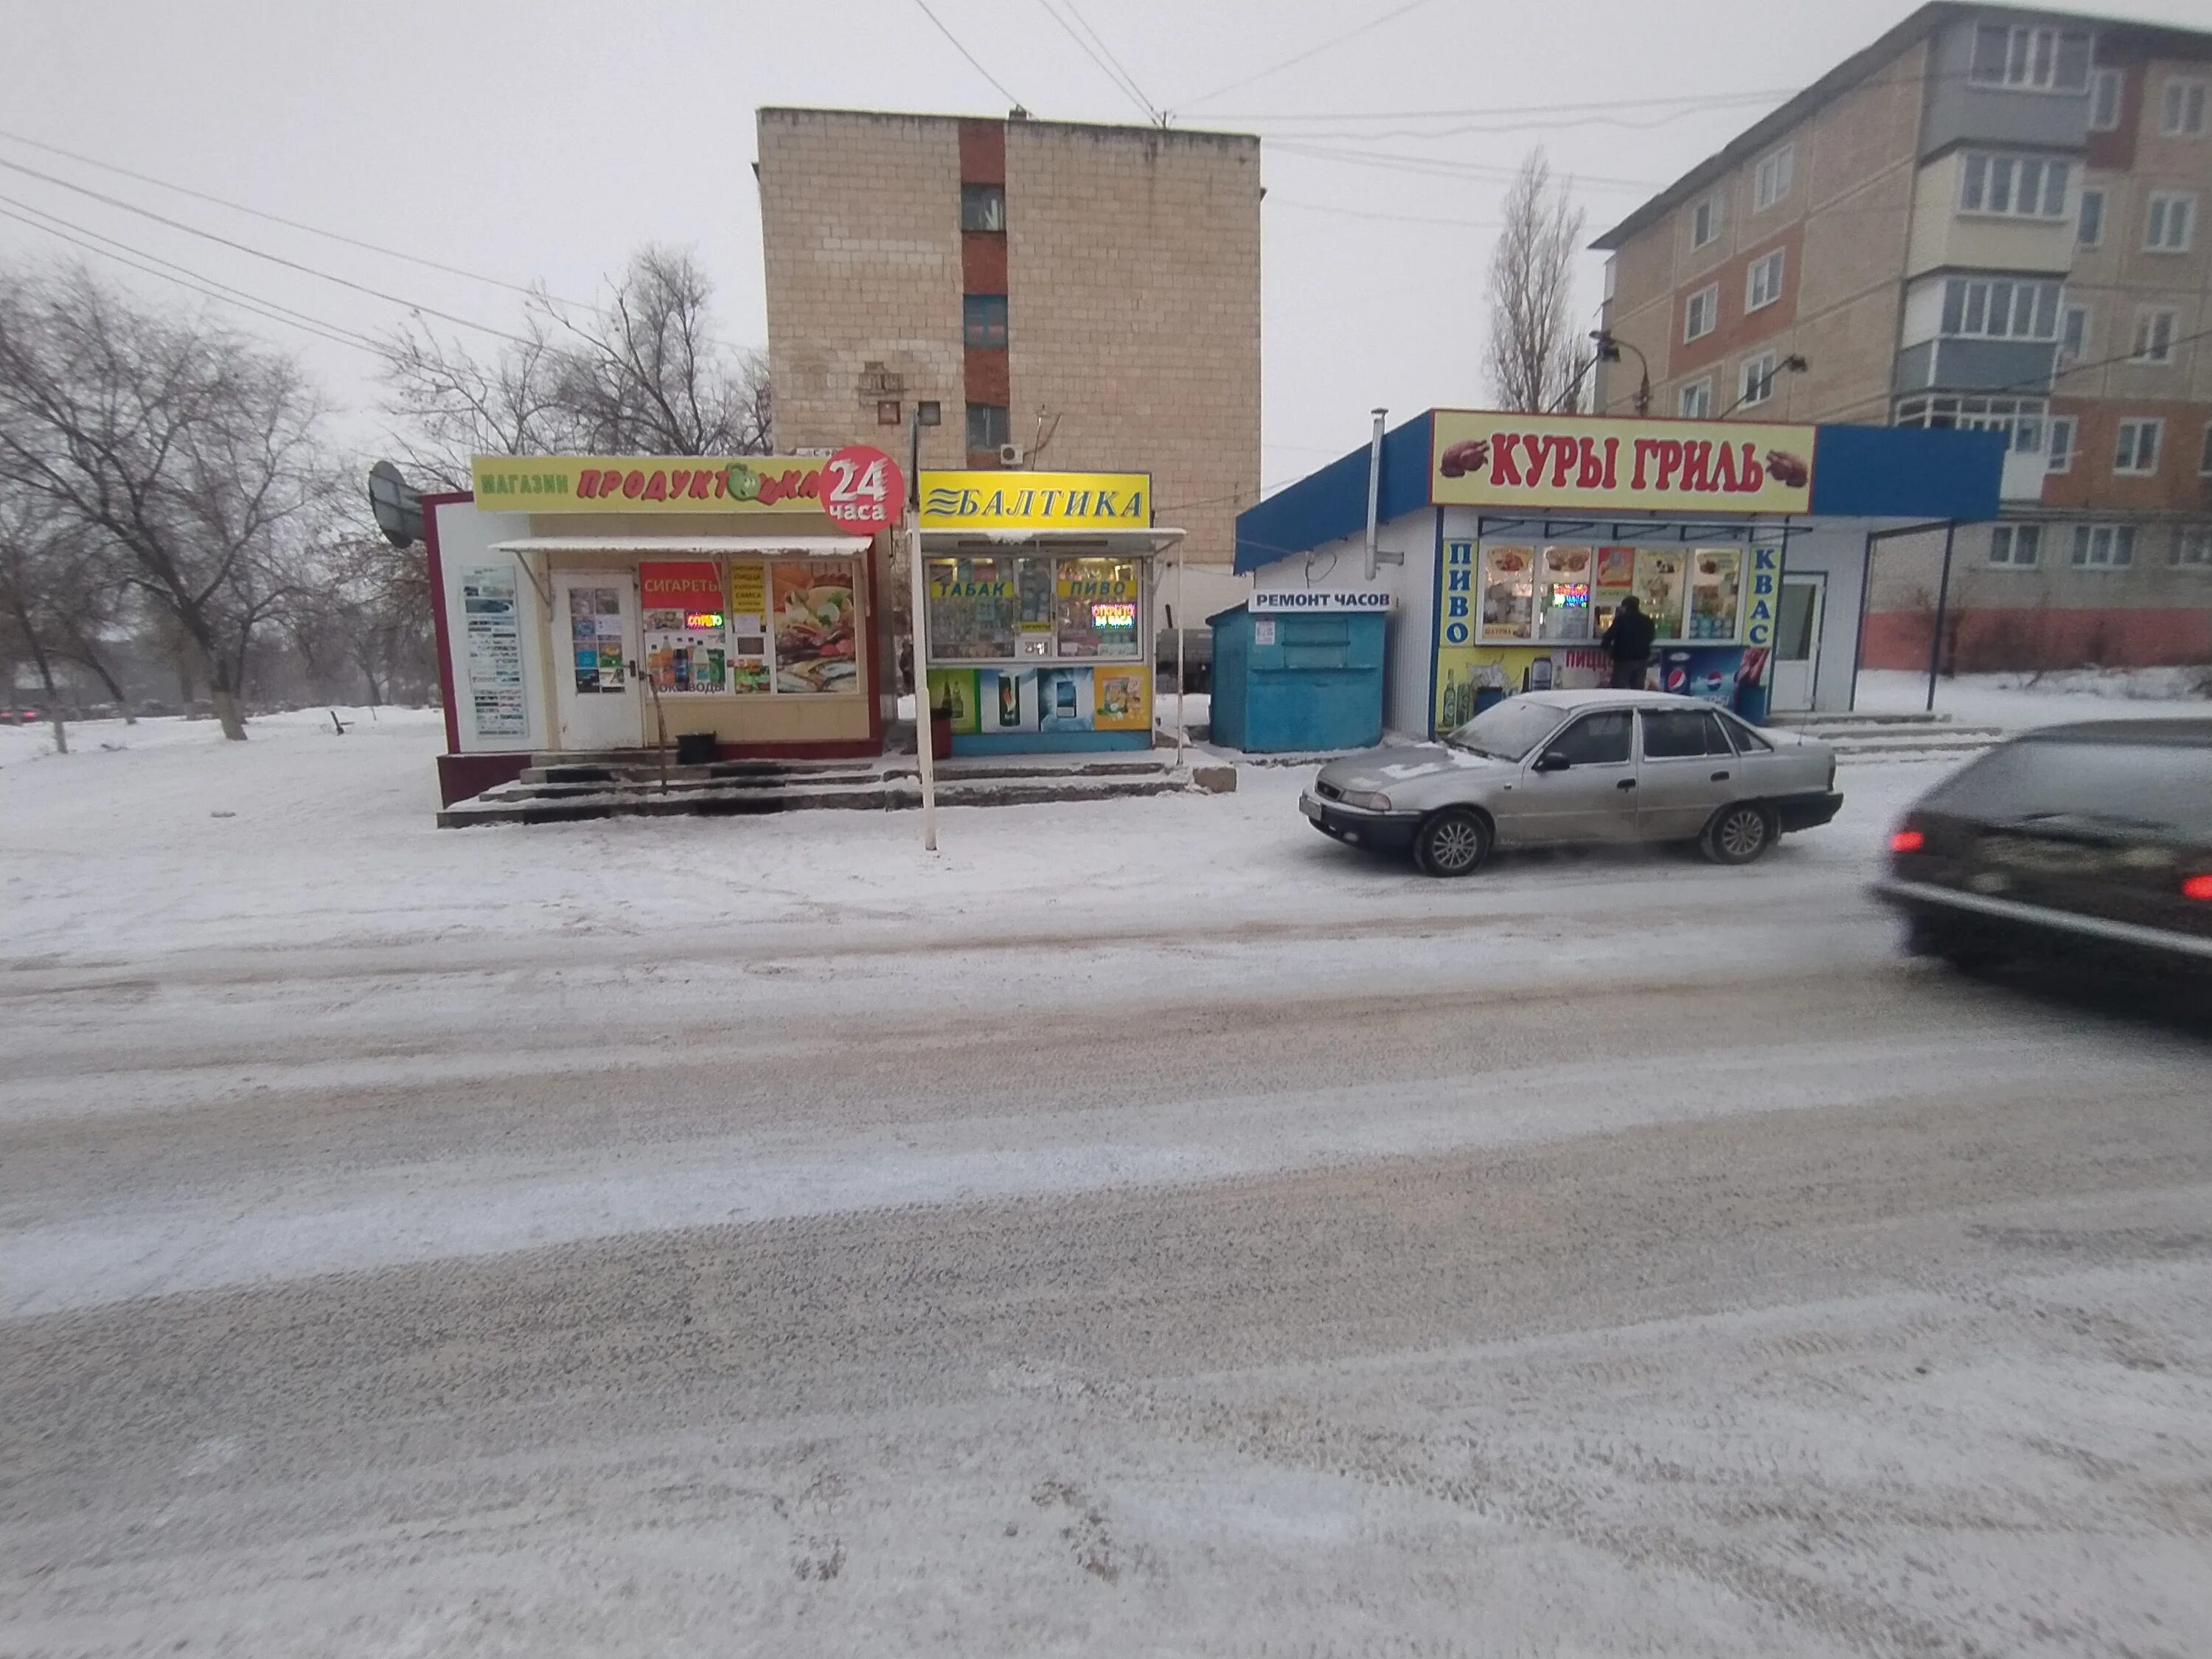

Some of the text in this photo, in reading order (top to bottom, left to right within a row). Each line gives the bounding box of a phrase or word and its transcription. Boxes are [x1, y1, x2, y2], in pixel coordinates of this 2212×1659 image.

[1489, 432, 1764, 493] КУРЫ ГРИЛЬ
[481, 473, 568, 495] МАГАЗИН
[830, 458, 888, 502] 24
[829, 504, 886, 521] часа
[956, 487, 1144, 517] БАЛТИКА
[940, 582, 1004, 597] ТАБАК
[1071, 580, 1126, 595] ПИВО
[1256, 594, 1391, 607] РЕМОНТ ЧАСОВ
[1446, 543, 1472, 644] ПИВО
[1748, 549, 1777, 644] КВАС
